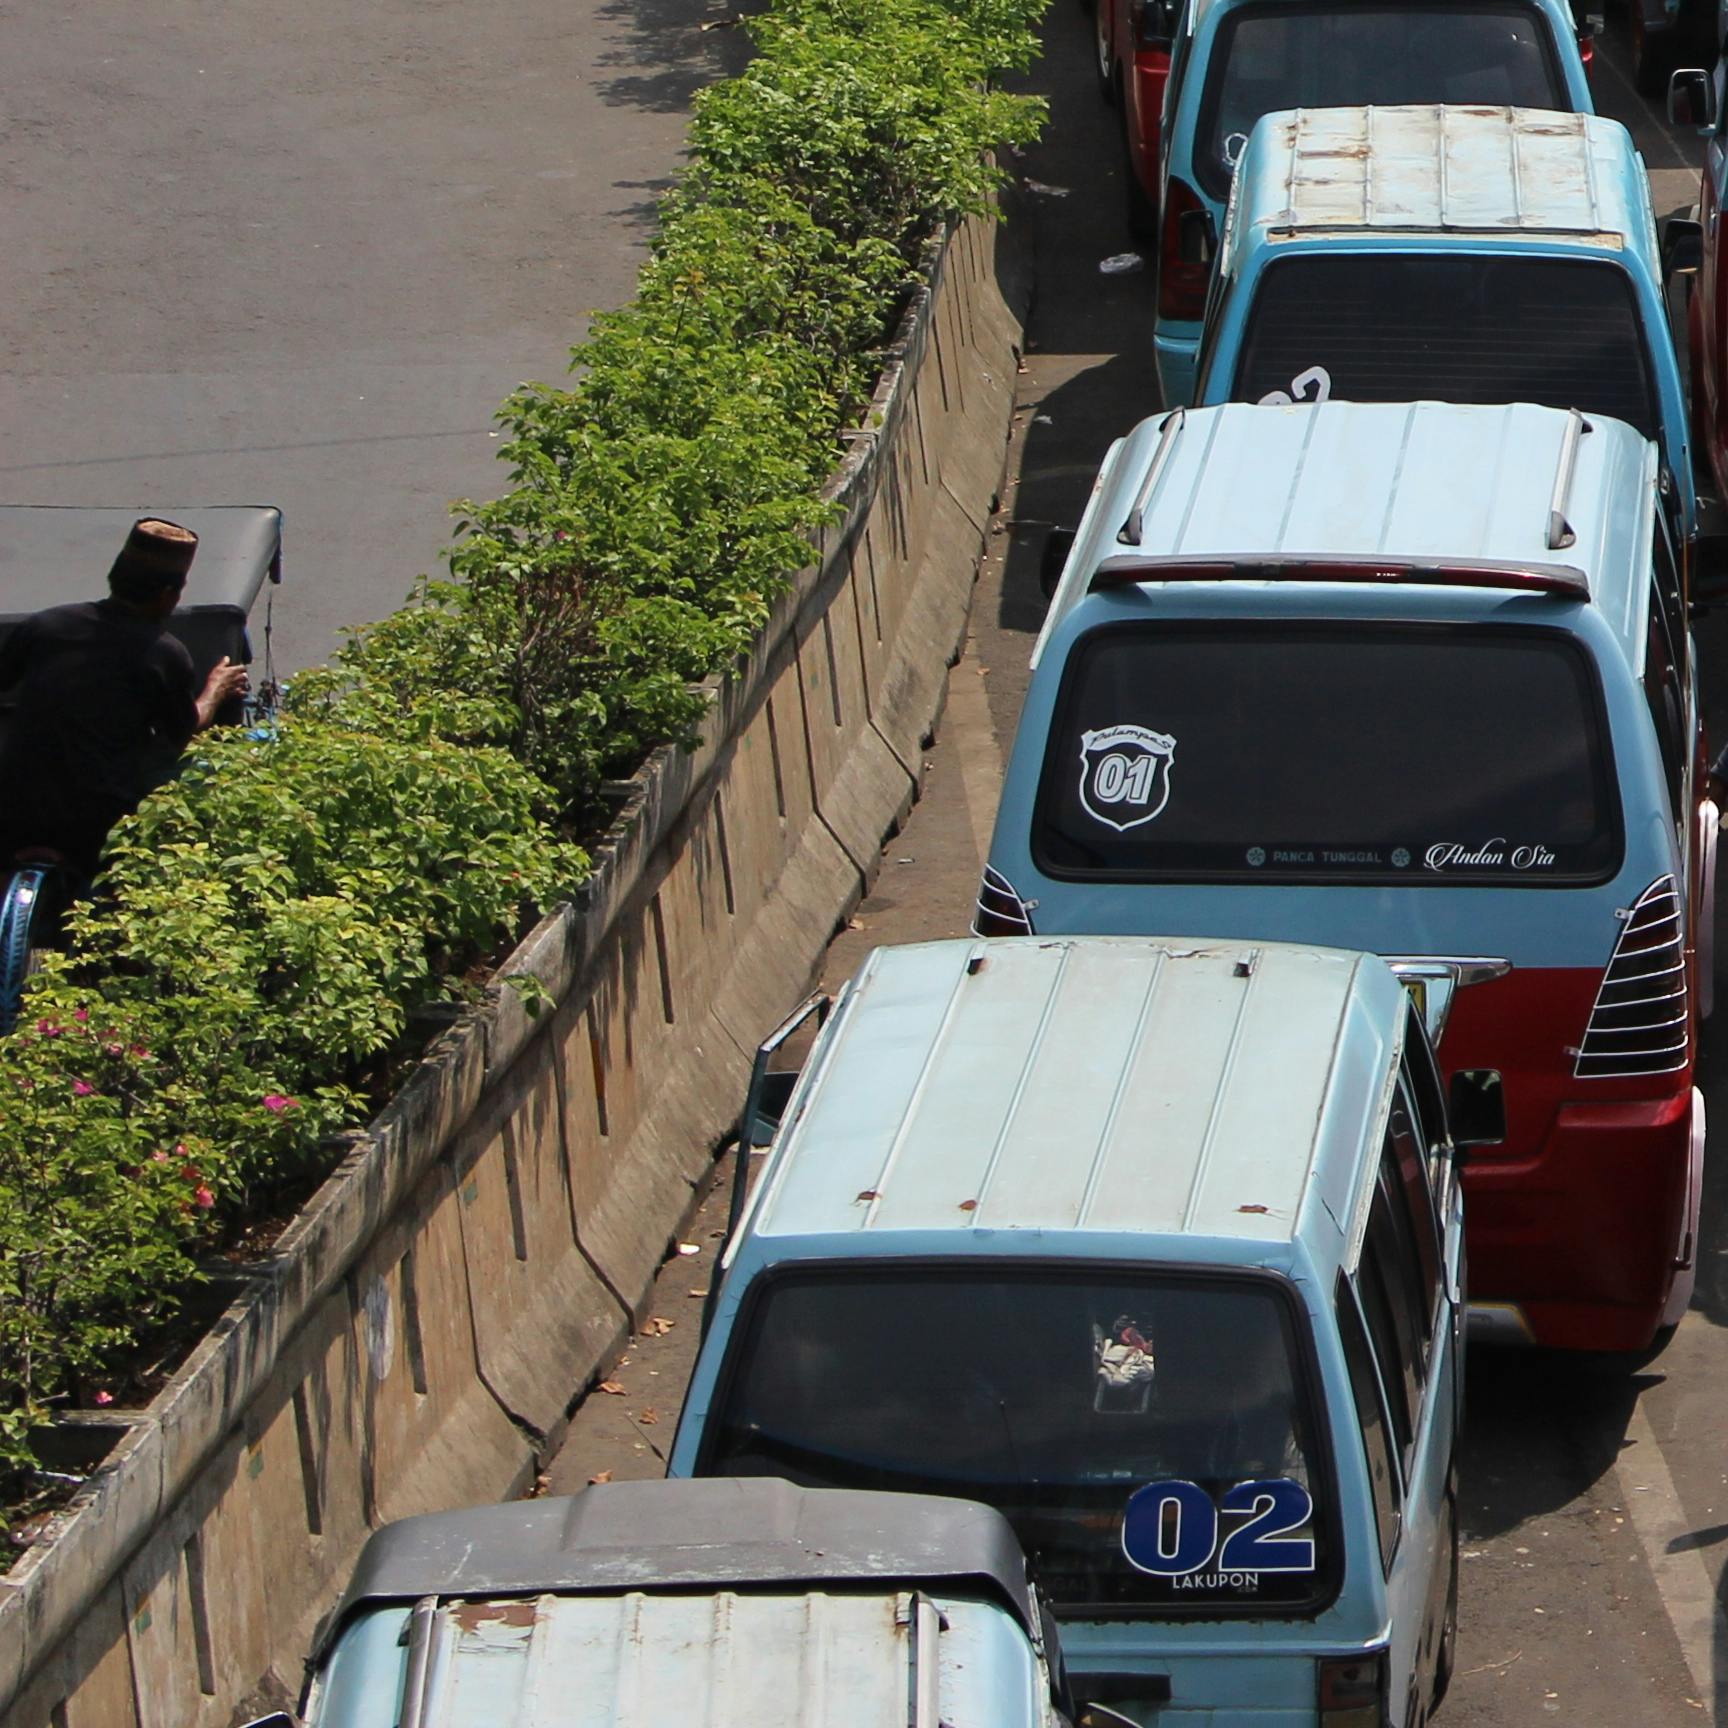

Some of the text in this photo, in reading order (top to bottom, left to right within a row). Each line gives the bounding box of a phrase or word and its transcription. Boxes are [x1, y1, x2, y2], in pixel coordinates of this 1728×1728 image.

[1094, 753, 1158, 805] 01
[1273, 851, 1383, 863] PANCA TUNGGAL
[1423, 838, 1556, 872] Andan Sia
[1121, 1478, 1316, 1577] 02
[1172, 1572, 1259, 1590] LAKUPON
